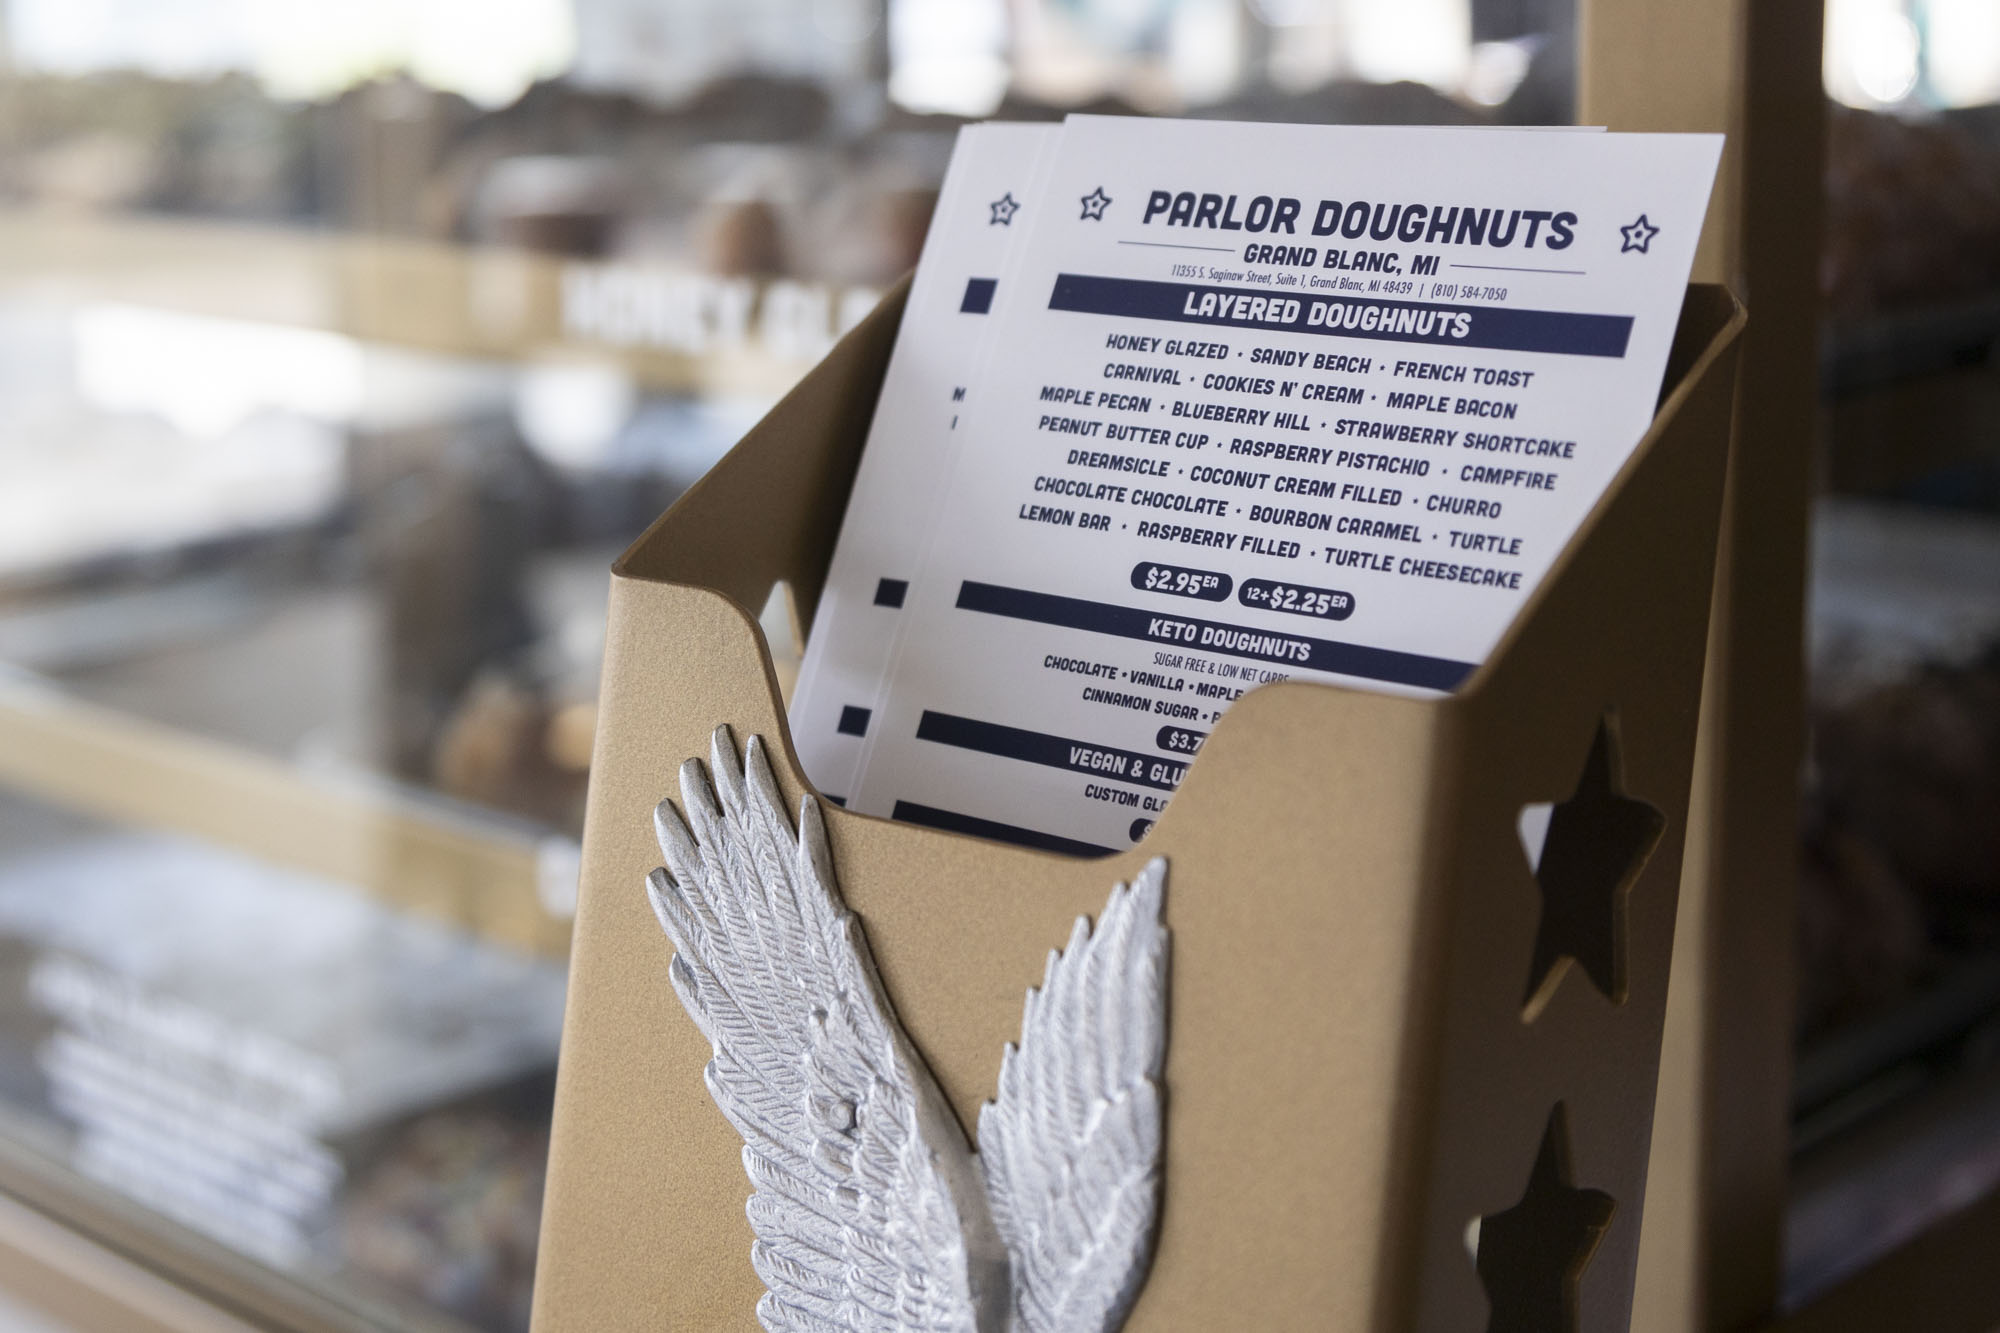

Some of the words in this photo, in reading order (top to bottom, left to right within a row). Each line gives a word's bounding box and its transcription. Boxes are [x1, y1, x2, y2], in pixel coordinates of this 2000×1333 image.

[1143, 190, 1301, 234] PARLOR
[1311, 200, 1578, 250] DOUGHNUTS
[1171, 264, 1197, 278] 11355
[1208, 267, 1244, 283] Saginaw
[1246, 270, 1272, 286] Street,
[1275, 272, 1297, 286] Suite
[1310, 275, 1339, 289] Grand
[1339, 277, 1365, 293] Blanc,
[1367, 280, 1381, 292] MI
[1382, 281, 1413, 294] 48439
[1431, 283, 1458, 301] (810)
[1460, 285, 1507, 301] 584-7050
[1244, 243, 1317, 267] GRAND
[1323, 249, 1402, 276] BLANC,
[1410, 255, 1440, 276] MI
[1183, 291, 1301, 323] LAYERED
[1307, 302, 1472, 338] DOUGHNUTS
[1106, 334, 1162, 353] HONEY
[1165, 340, 1229, 360] GLAZED
[1250, 348, 1310, 367] SANDY
[1313, 353, 1372, 374] BEACH
[1393, 361, 1467, 382] FRENCH
[1473, 368, 1535, 388] TOAST
[1104, 363, 1181, 386] CARNIVAL
[1203, 374, 1275, 395] COOKIES
[1302, 384, 1365, 405] CREAM
[1386, 392, 1450, 413] MAPLE
[1454, 398, 1518, 419] BACON
[1040, 386, 1095, 406] MAPLE
[1098, 392, 1152, 413] PECAN
[1171, 401, 1270, 426] BLUEBERRY
[1273, 412, 1310, 431] HILL
[1334, 419, 1459, 446] STRAWBERRY
[1463, 432, 1576, 459] SHORTCAKE
[1039, 415, 1103, 437] PEANUT
[1106, 423, 1171, 446] BUTTER
[1175, 432, 1209, 450] CUP
[1229, 438, 1333, 465] RASPBERRY
[1336, 450, 1430, 477] PISTACHIO
[1460, 465, 1558, 490] CAMPFIRE
[1067, 449, 1171, 477] DREAMSICLE
[1190, 465, 1271, 489] COCONUT
[1274, 476, 1336, 498] CREAM
[1340, 484, 1402, 506] FILLED
[1426, 495, 1502, 519] CHURRO
[1034, 476, 1128, 503] CHOCOLATE
[1131, 489, 1229, 517] CHOCOLATE
[1249, 505, 1333, 531] BOURBON
[1337, 517, 1422, 543] CARAMEL
[1450, 531, 1523, 555] TURTLE
[1019, 504, 1075, 526] LEMON
[1078, 512, 1111, 531] BAR
[1137, 521, 1238, 549] RASPBERRY
[1240, 535, 1301, 559] FILLED
[1325, 547, 1395, 572] TURTLE
[1399, 558, 1522, 590] CHEESECAKE
[1148, 618, 1197, 641] KETO
[1201, 627, 1311, 661] DOUGHNUTS
[1044, 655, 1119, 680] CHOCOLATE
[1130, 670, 1184, 692] VANILLA
[1153, 652, 1183, 669] SUGAR
[1184, 657, 1207, 673] FREE
[1208, 662, 1215, 674] &
[1217, 663, 1240, 678] LOW
[1239, 667, 1258, 681] NET
[1082, 687, 1152, 712] CINNAMON
[1154, 701, 1199, 721] SUGAR
[1070, 747, 1127, 774] VEGAN
[1131, 760, 1143, 778] &
[1150, 763, 1189, 786] GLU
[1084, 784, 1140, 807] CUSTOM
